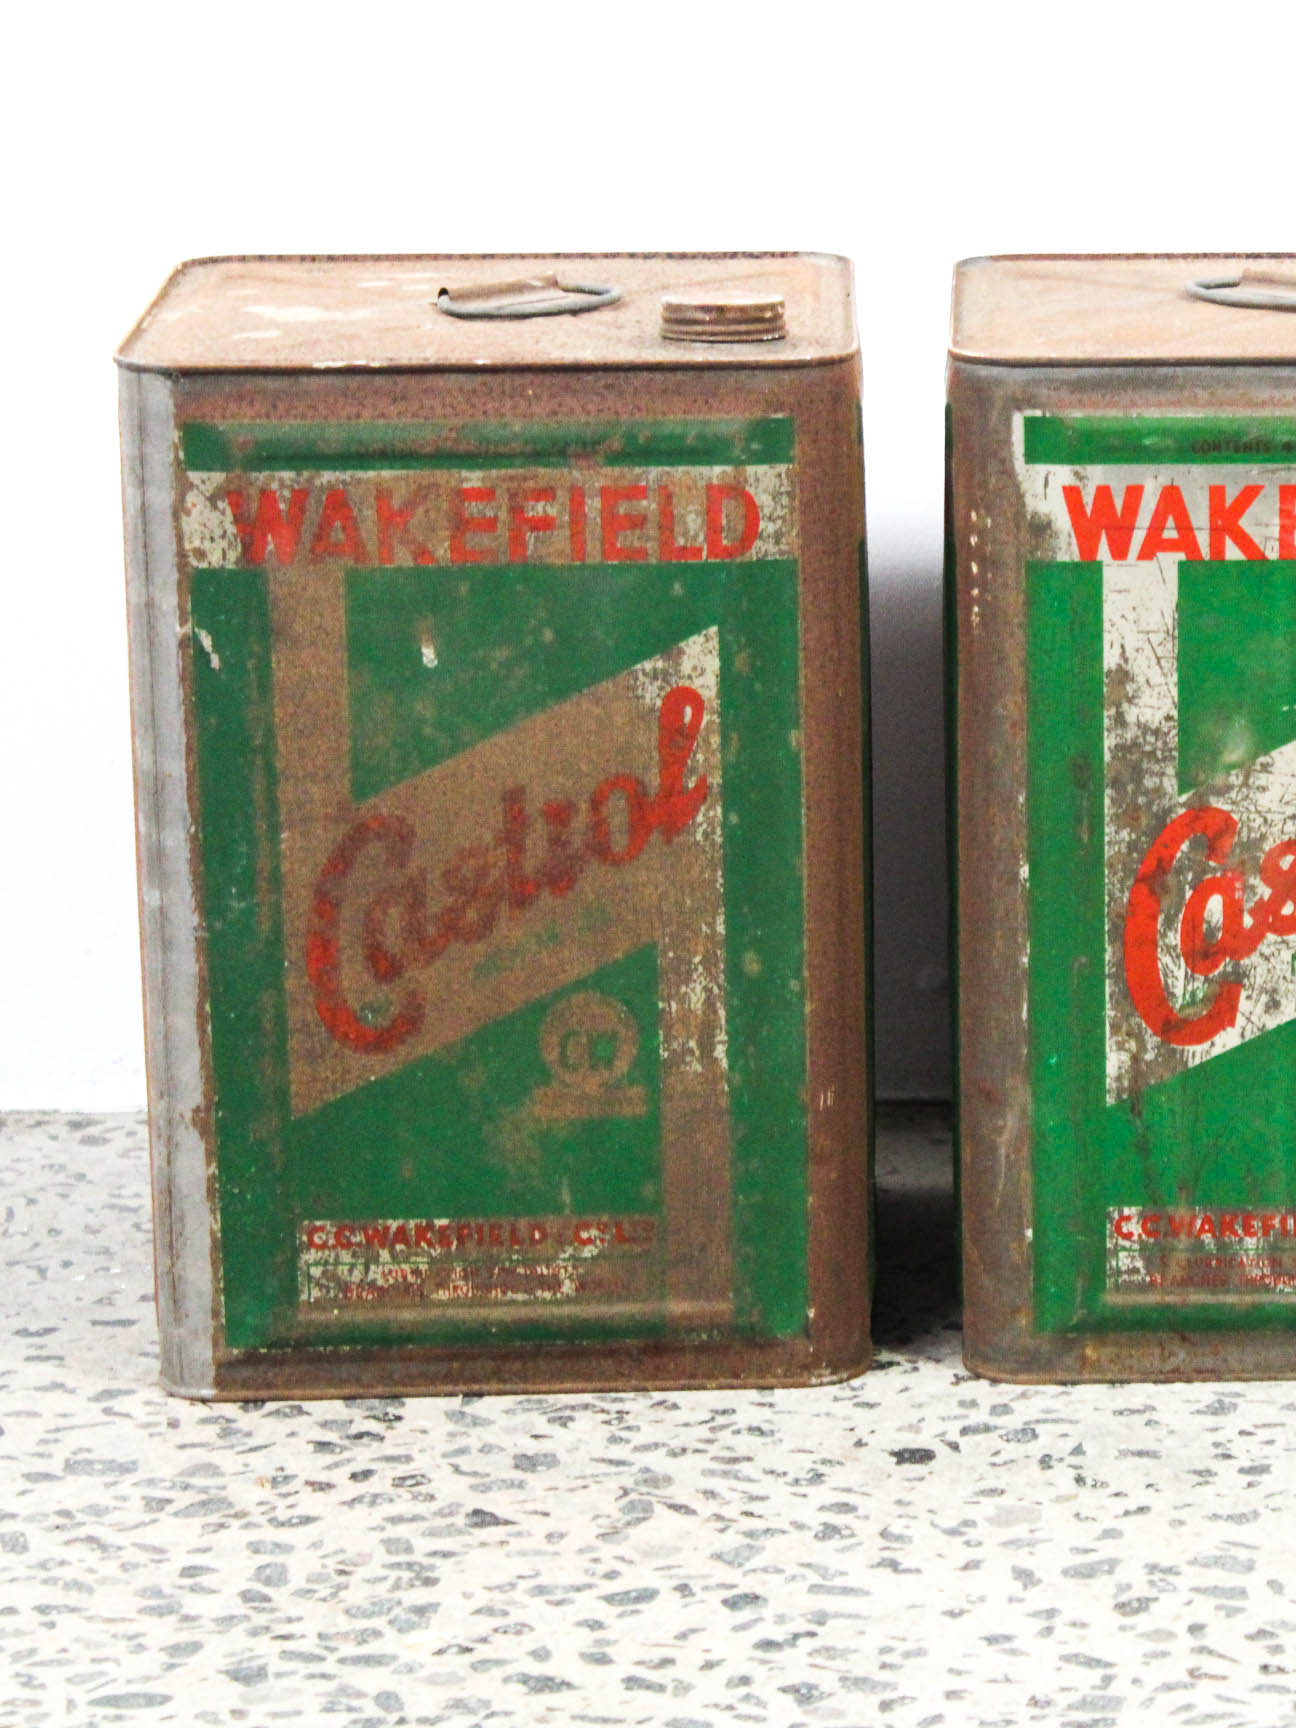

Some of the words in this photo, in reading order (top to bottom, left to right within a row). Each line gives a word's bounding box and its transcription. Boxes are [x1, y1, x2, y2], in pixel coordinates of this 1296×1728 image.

[1191, 439, 1273, 455] CONTENTS
[227, 483, 761, 565] WAKEFIELD
[306, 685, 709, 1056] Castrol
